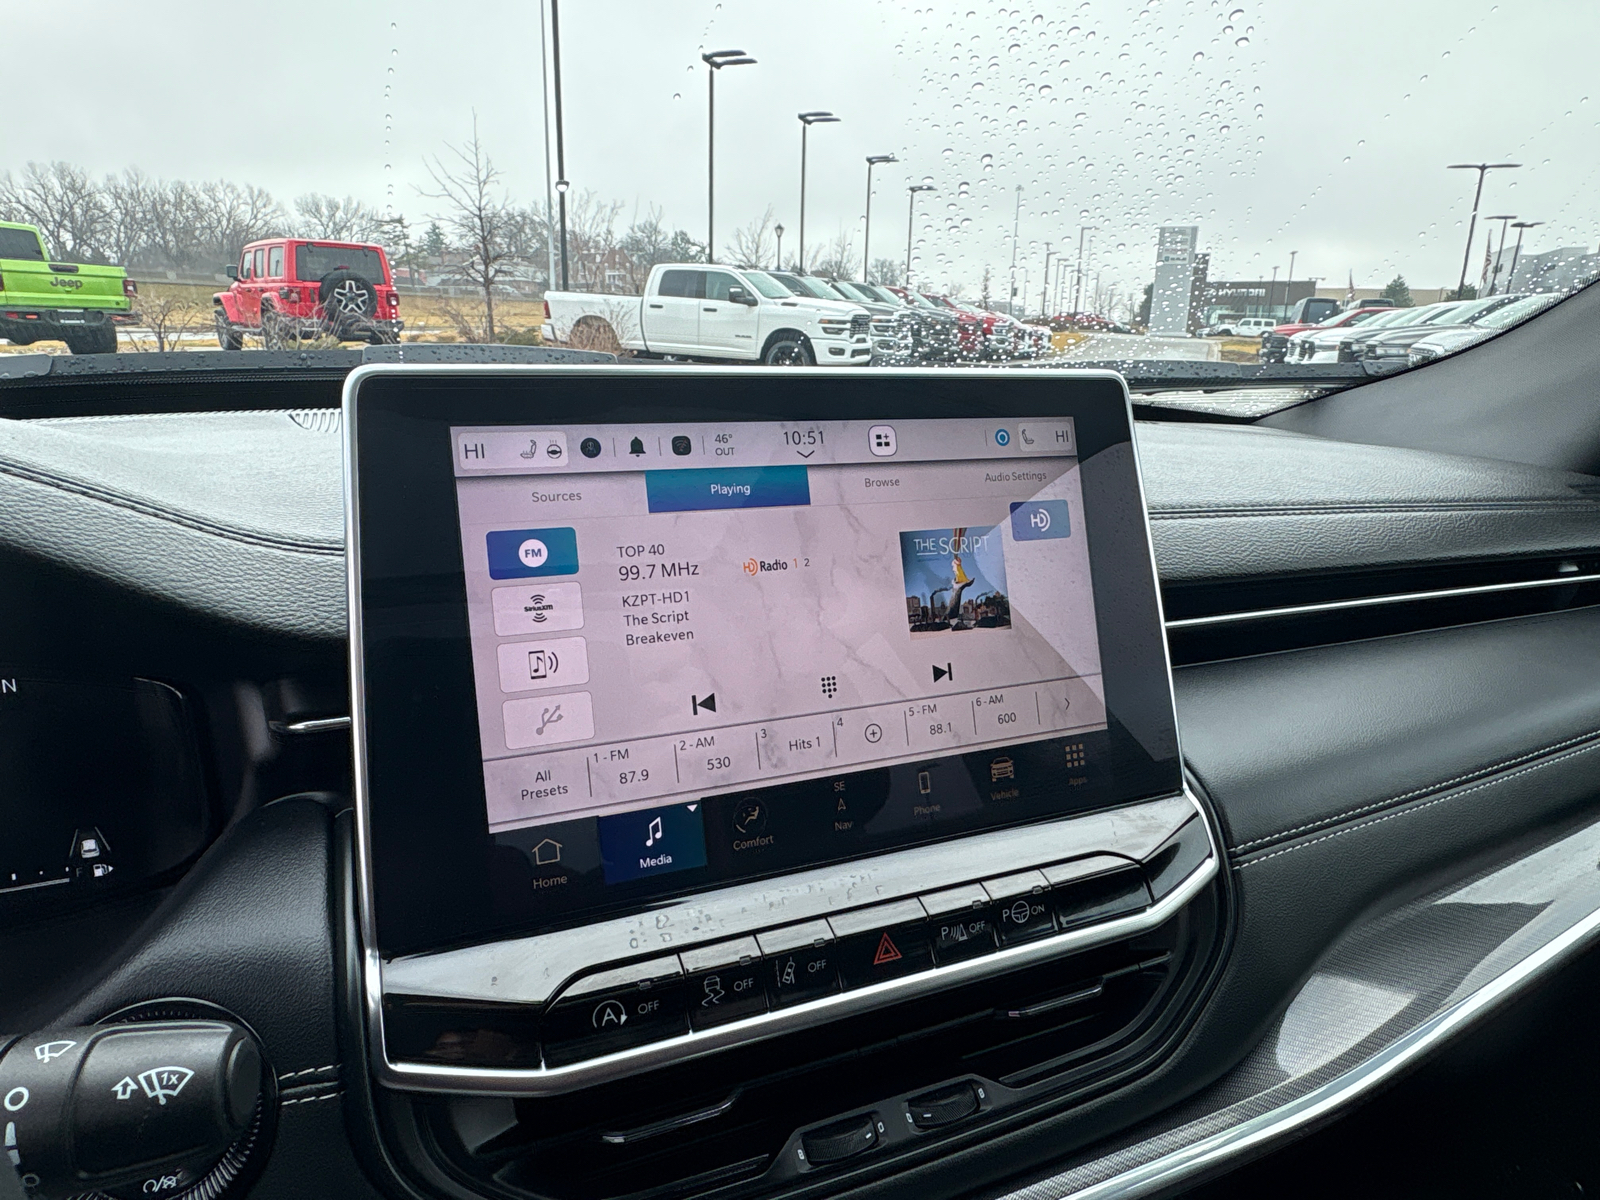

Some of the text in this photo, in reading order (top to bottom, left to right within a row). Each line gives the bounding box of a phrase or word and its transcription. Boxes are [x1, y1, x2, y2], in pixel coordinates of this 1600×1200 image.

[50, 276, 83, 290] Jeep
[1218, 288, 1266, 297] HYUNDAI
[714, 433, 733, 444] 46°
[783, 430, 825, 446] 10:51
[1055, 429, 1069, 443] HI
[464, 443, 485, 460] HI
[715, 447, 735, 456] OUT
[864, 476, 900, 488] Browse
[985, 471, 1047, 483] Audio Settings
[532, 490, 582, 503] Sources
[710, 483, 751, 497] Playing
[616, 544, 665, 559] TOP 40
[913, 535, 990, 555] THE SCRIPT
[524, 548, 542, 558] FM
[760, 559, 788, 572] Radio
[793, 558, 810, 569] 1 2
[618, 561, 700, 581] 99.7 MHz
[622, 591, 690, 608] KZPT-HD1
[623, 610, 690, 627] The Script
[625, 629, 695, 646] Breakeven
[975, 696, 982, 707] 6
[987, 694, 1004, 706] AM
[908, 706, 915, 717] 5
[922, 703, 938, 716] FM
[836, 717, 844, 728] 4
[997, 712, 1017, 725] 600
[760, 728, 767, 739] 3
[929, 722, 952, 735] 88.1
[679, 739, 687, 751] 2
[695, 736, 715, 749] AM
[789, 736, 821, 751] Hits 1
[593, 752, 599, 764] 1
[610, 749, 630, 762] FM
[706, 756, 731, 771] 530
[535, 769, 551, 783] All
[619, 768, 649, 785] 87.9
[1068, 776, 1088, 788] Apps
[520, 784, 568, 801] Presets
[833, 781, 846, 792] SE
[990, 787, 1019, 801] Vehicle
[913, 802, 941, 816] Phone
[834, 820, 853, 831] Nav
[732, 834, 774, 851] Comfort
[639, 853, 673, 869] Media
[76, 868, 83, 877] F
[532, 873, 568, 889] Home
[1002, 904, 1045, 922] P ON
[941, 921, 985, 940] P OFF
[807, 959, 827, 973] OFF
[733, 977, 754, 992] OFF
[638, 1000, 660, 1015] OFF
[160, 1071, 180, 1086] 1x
